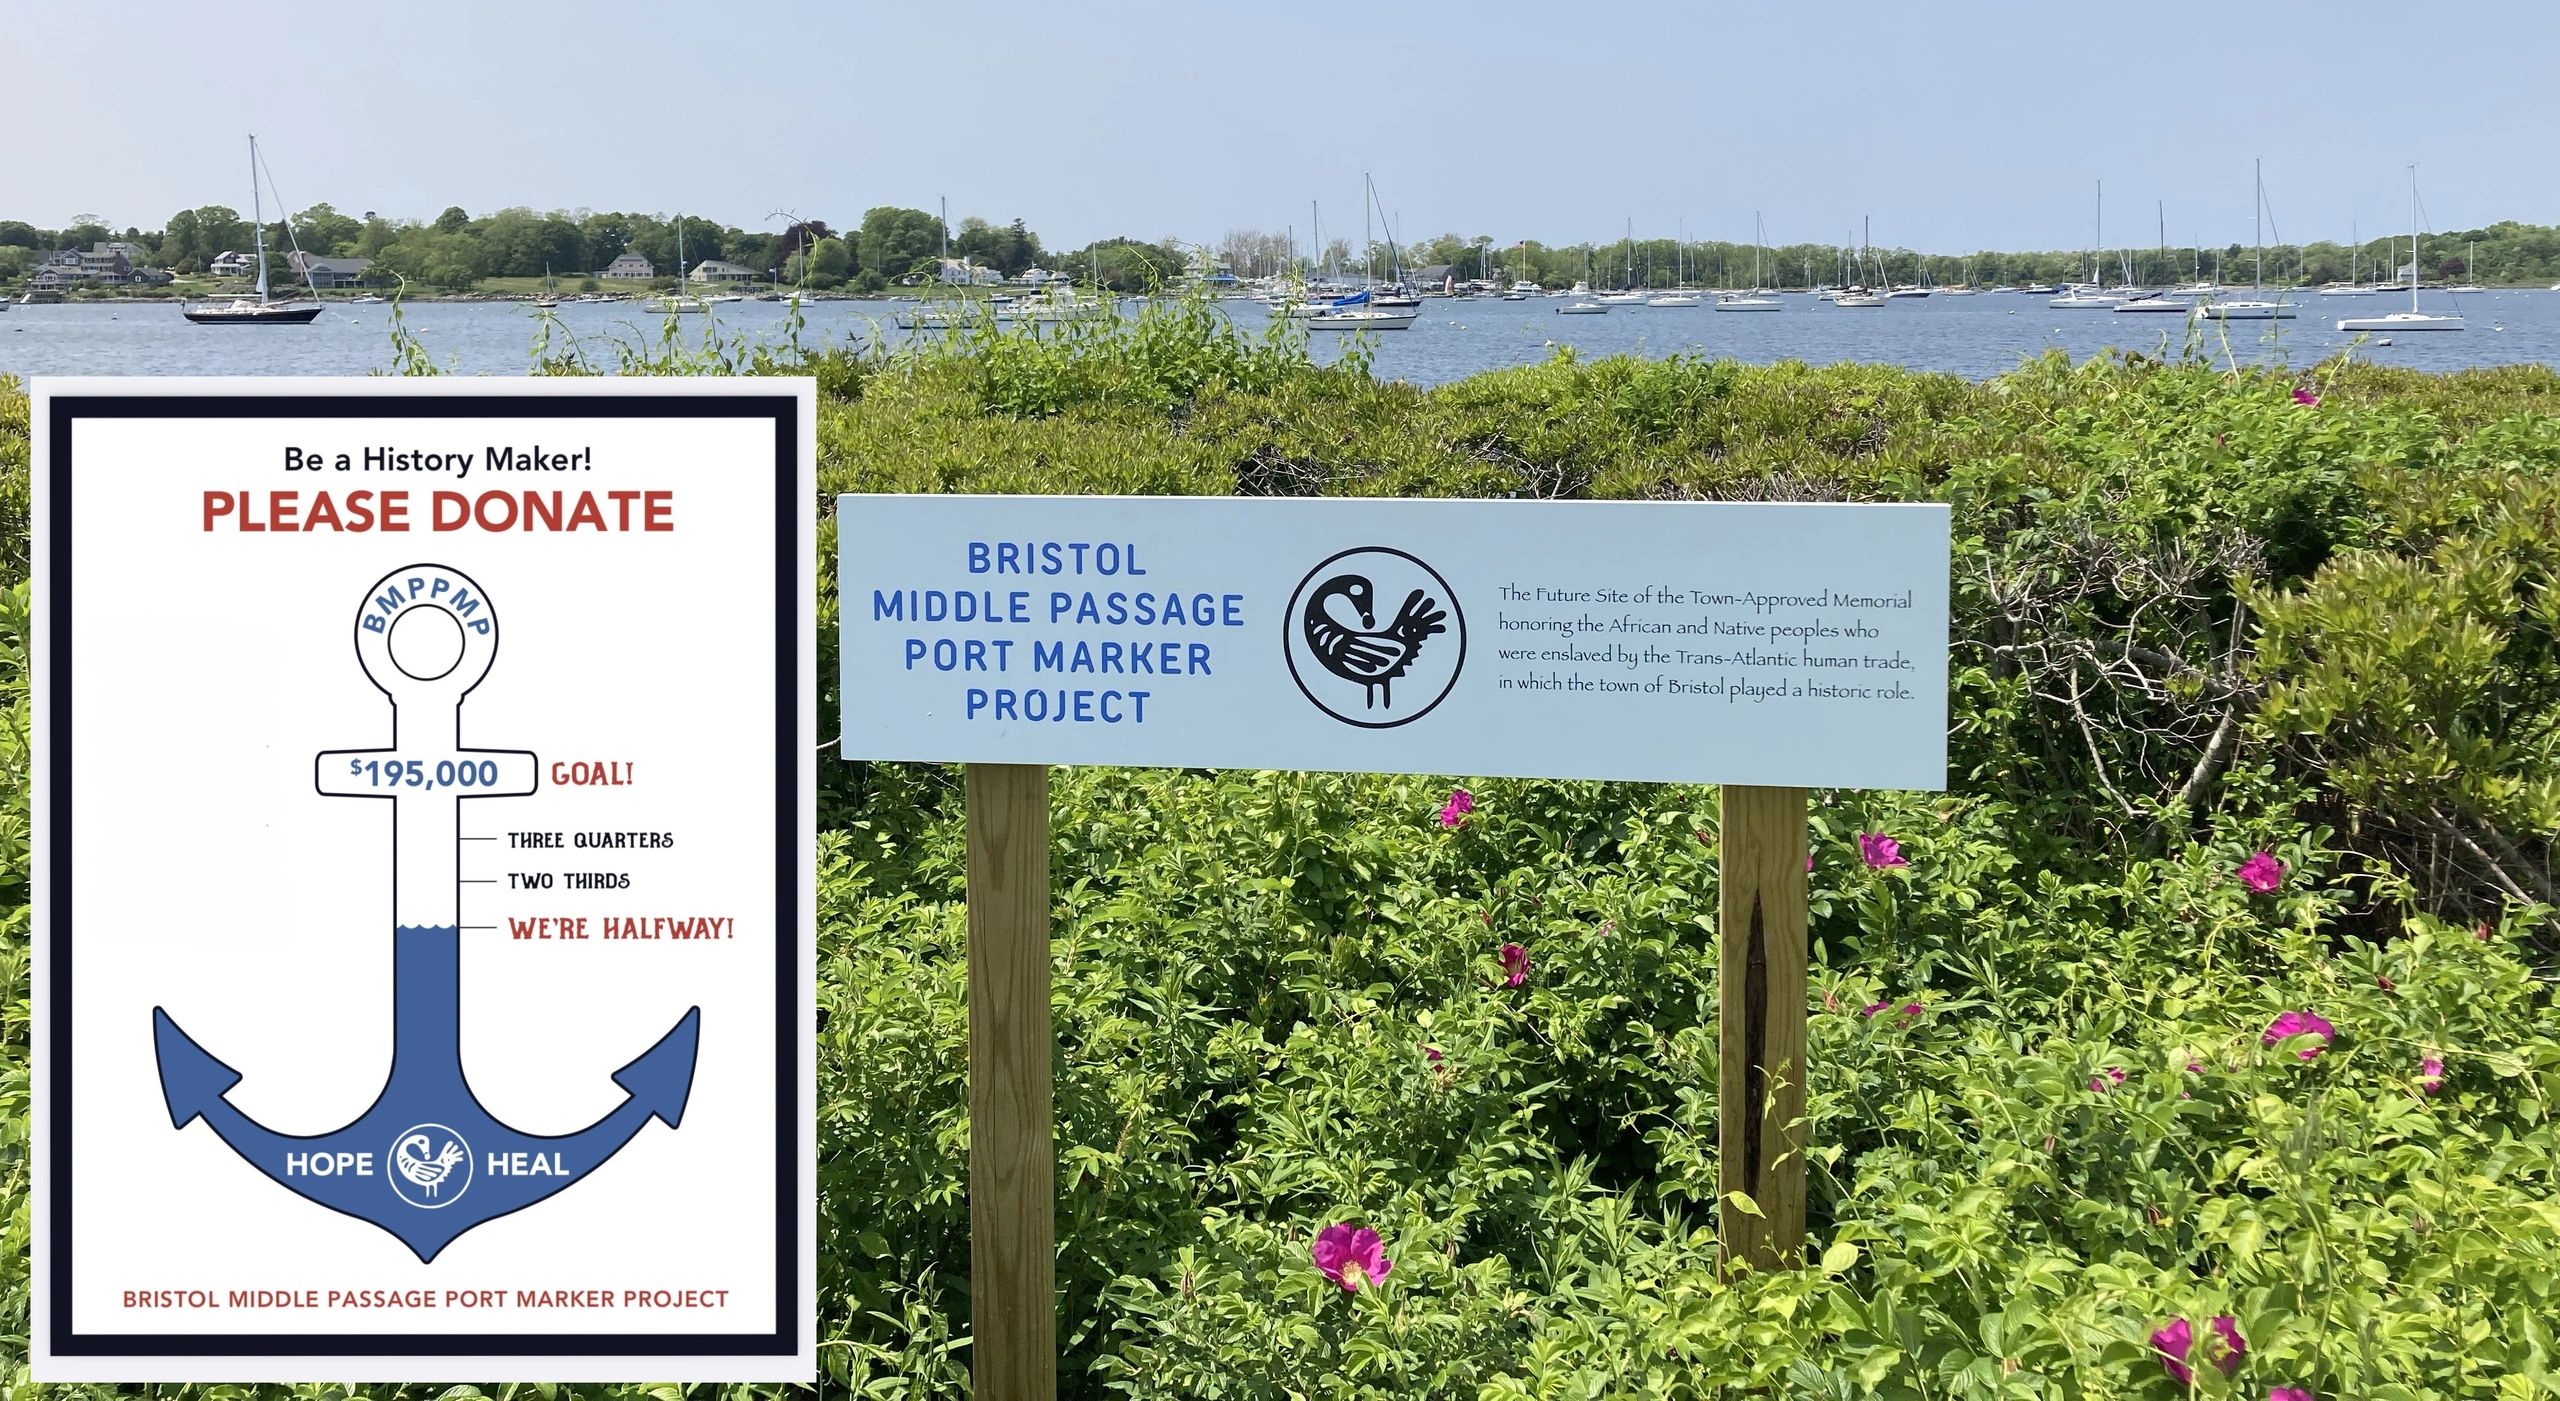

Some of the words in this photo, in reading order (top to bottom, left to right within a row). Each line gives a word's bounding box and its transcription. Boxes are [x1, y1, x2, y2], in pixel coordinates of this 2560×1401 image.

[968, 541, 1147, 577] BRISTOL
[873, 589, 1031, 624] MIDDLE
[1050, 591, 1245, 627] PASSAGE
[1497, 584, 1533, 602] The
[1535, 586, 1592, 603] Future
[1594, 587, 1629, 605] Site
[1632, 584, 1654, 605] of
[1655, 585, 1686, 606] the
[1688, 587, 1829, 616] Town-Approved
[1832, 589, 1913, 609] Memorial
[1498, 611, 1575, 640] honoring
[1576, 614, 1606, 633] the
[1607, 615, 1673, 635] African
[1675, 615, 1710, 636] and
[1713, 620, 1767, 638] Native
[1769, 617, 1840, 646] peoples
[1843, 619, 1880, 640] who
[905, 638, 1014, 672] PORT
[1033, 640, 1212, 676] MARKER
[1497, 648, 1537, 662] were
[1539, 642, 1614, 664] enslaved
[1616, 644, 1640, 671] by
[1642, 646, 1672, 665] the
[1674, 647, 1799, 670] Trans-Atlantic
[1802, 649, 1859, 669] human
[1862, 651, 1916, 673] trade,
[1498, 673, 1514, 689] in
[1516, 671, 1563, 692] which
[1566, 673, 1596, 692] the
[1598, 677, 1640, 695] town
[1643, 673, 1665, 696] of
[1667, 675, 1725, 696] Bristol
[1728, 677, 1789, 704] played
[1791, 686, 1803, 698] a
[1807, 680, 1873, 700] historic
[1876, 680, 1915, 701] role.
[966, 688, 1151, 724] PROJECT
